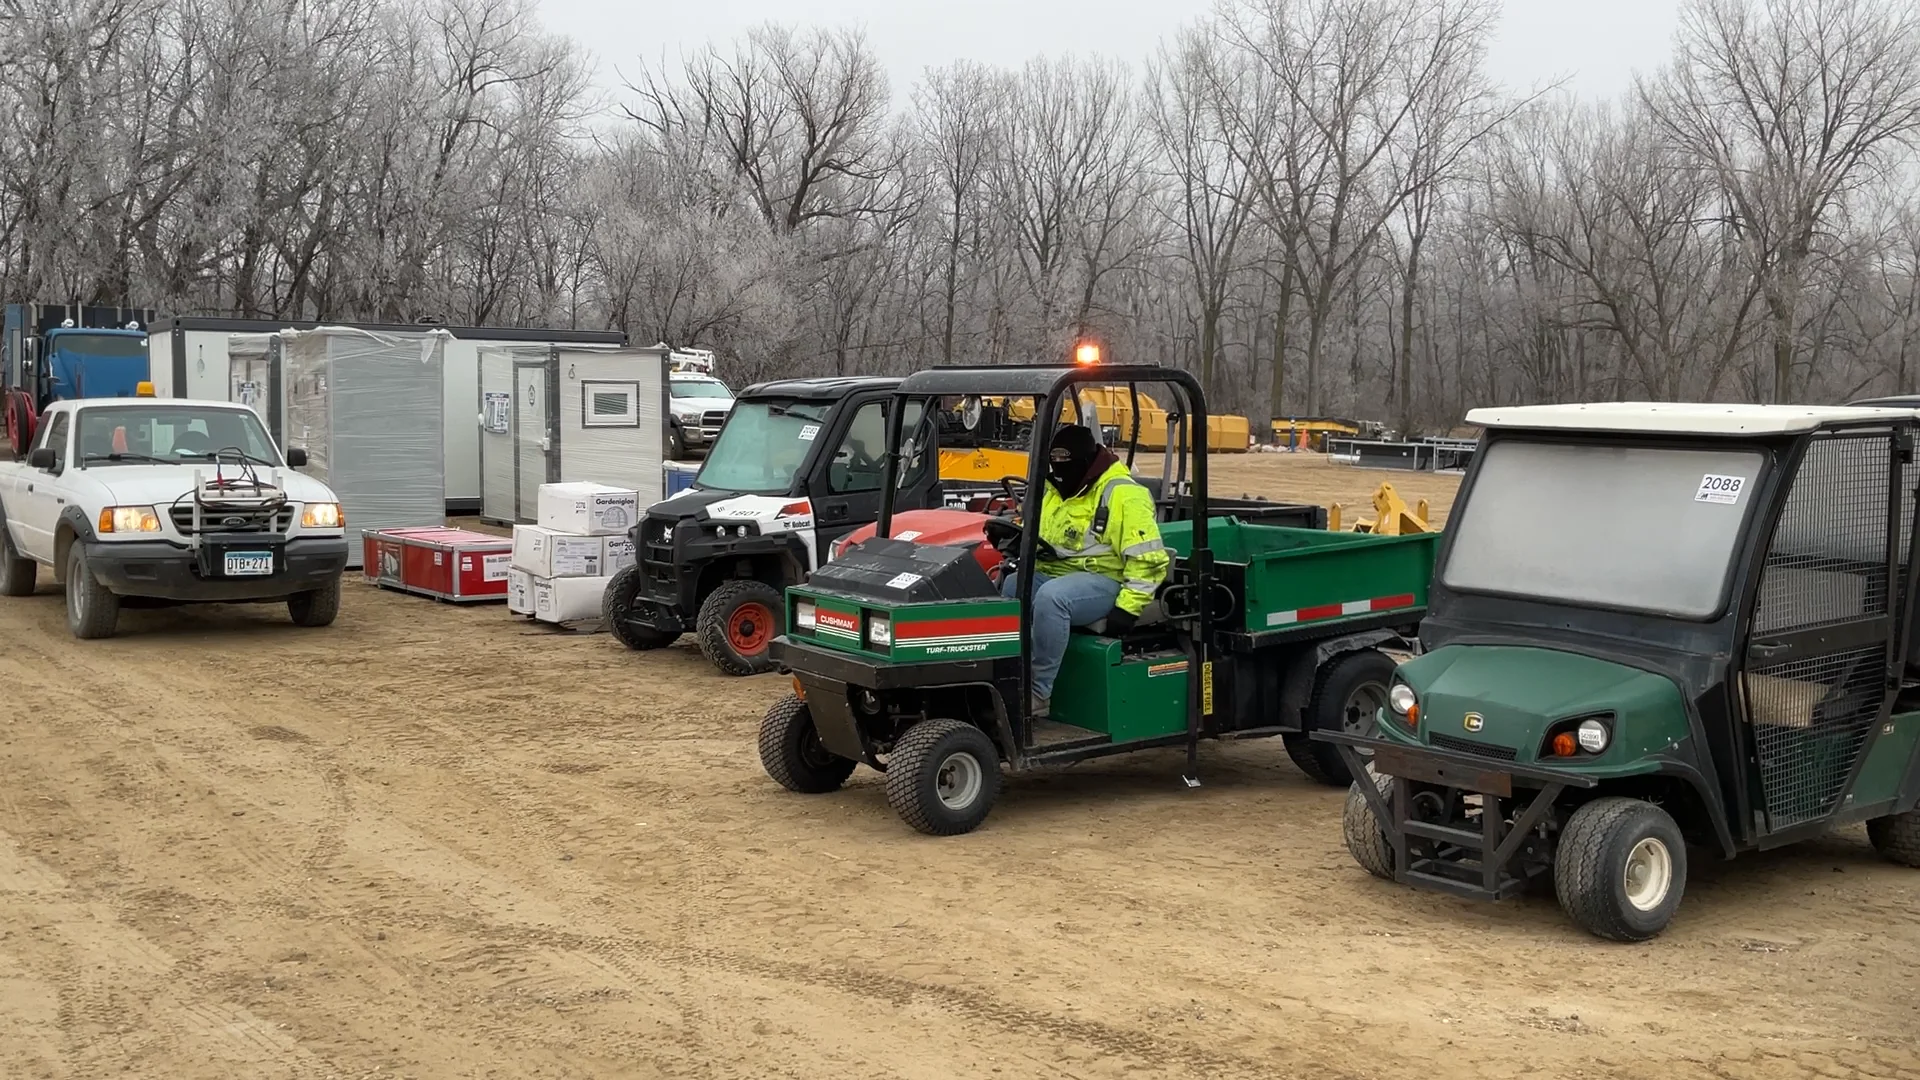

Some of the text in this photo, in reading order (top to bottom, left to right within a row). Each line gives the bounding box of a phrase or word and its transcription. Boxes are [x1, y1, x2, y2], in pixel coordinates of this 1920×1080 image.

[1702, 476, 1741, 491] 2088
[595, 497, 635, 506] Gardenigloo
[792, 520, 811, 528] Bobcat
[252, 557, 269, 570] 271
[820, 614, 854, 629] CUSHMAN
[925, 643, 988, 654] TURF-TRUCKSTER
[1204, 664, 1212, 713] DIESEL FUEL
